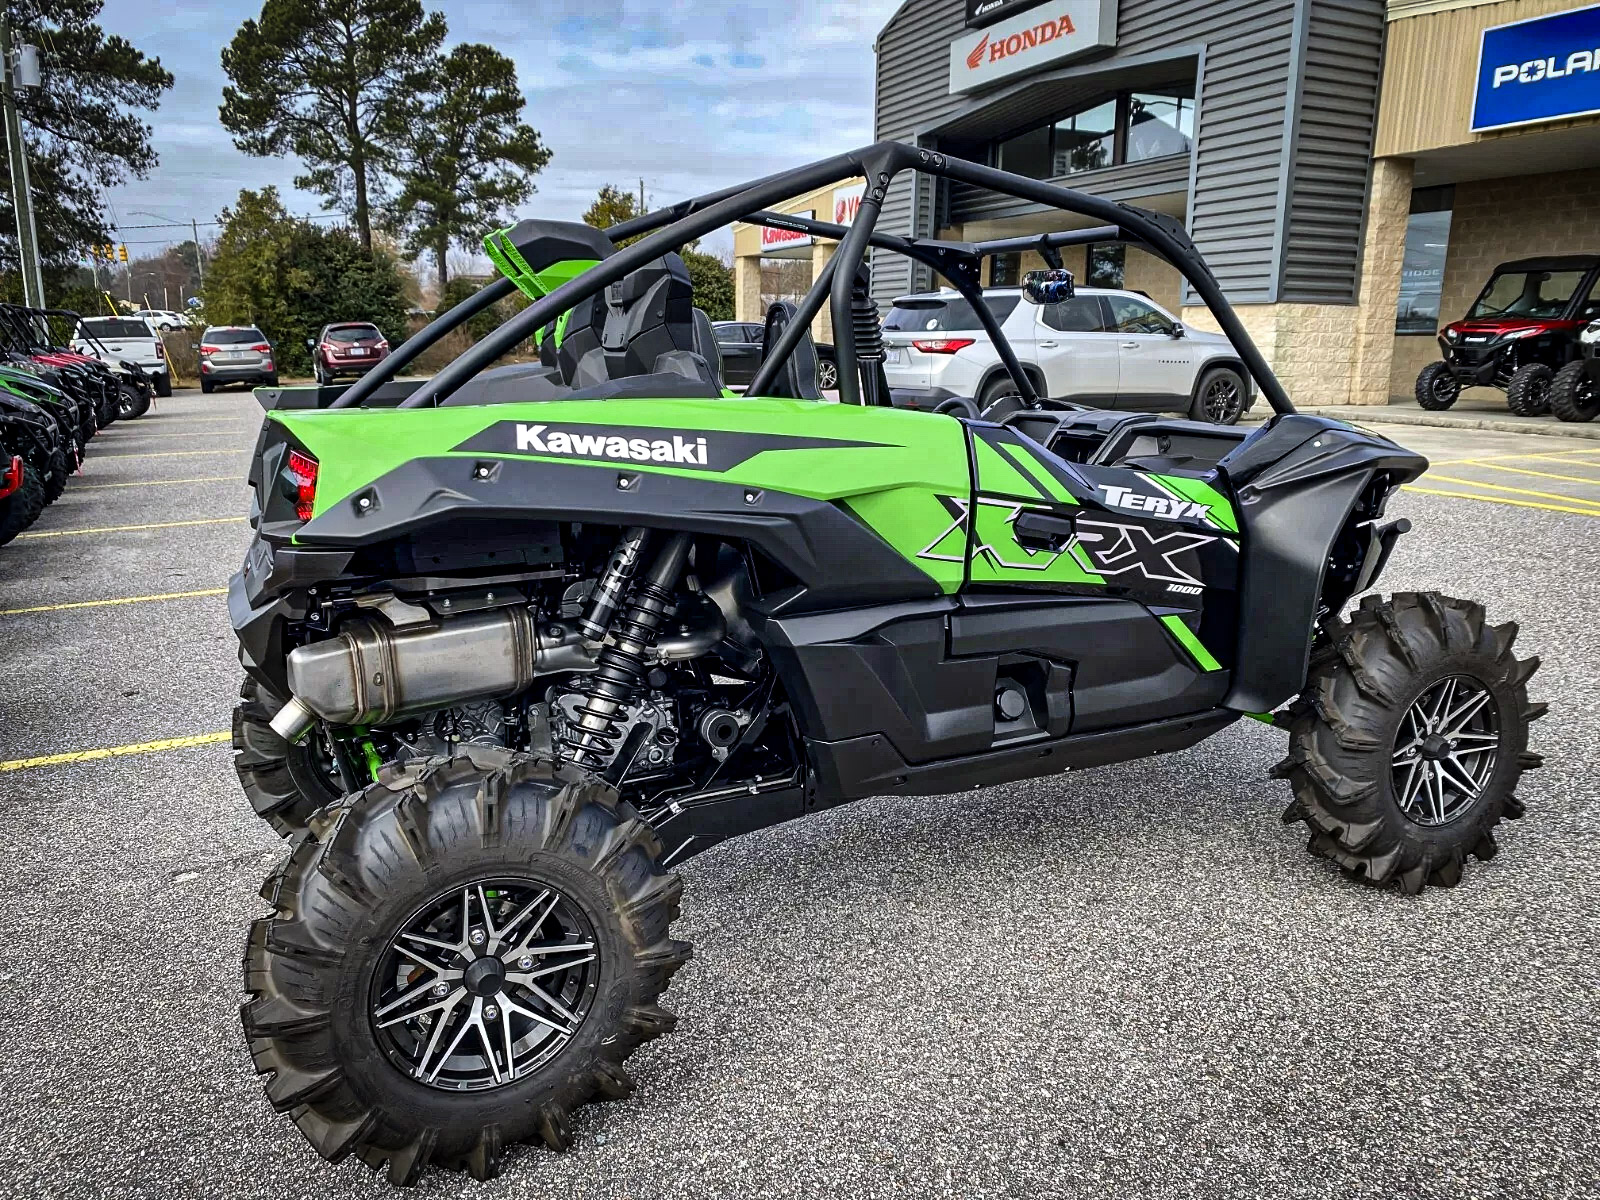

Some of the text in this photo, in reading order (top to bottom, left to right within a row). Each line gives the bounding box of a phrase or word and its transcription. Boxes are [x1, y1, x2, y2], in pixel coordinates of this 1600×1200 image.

[988, 14, 1076, 63] HONDA
[763, 226, 808, 245] Kawasa
[516, 423, 708, 465] Kawasaki
[1166, 583, 1204, 596] 1000
